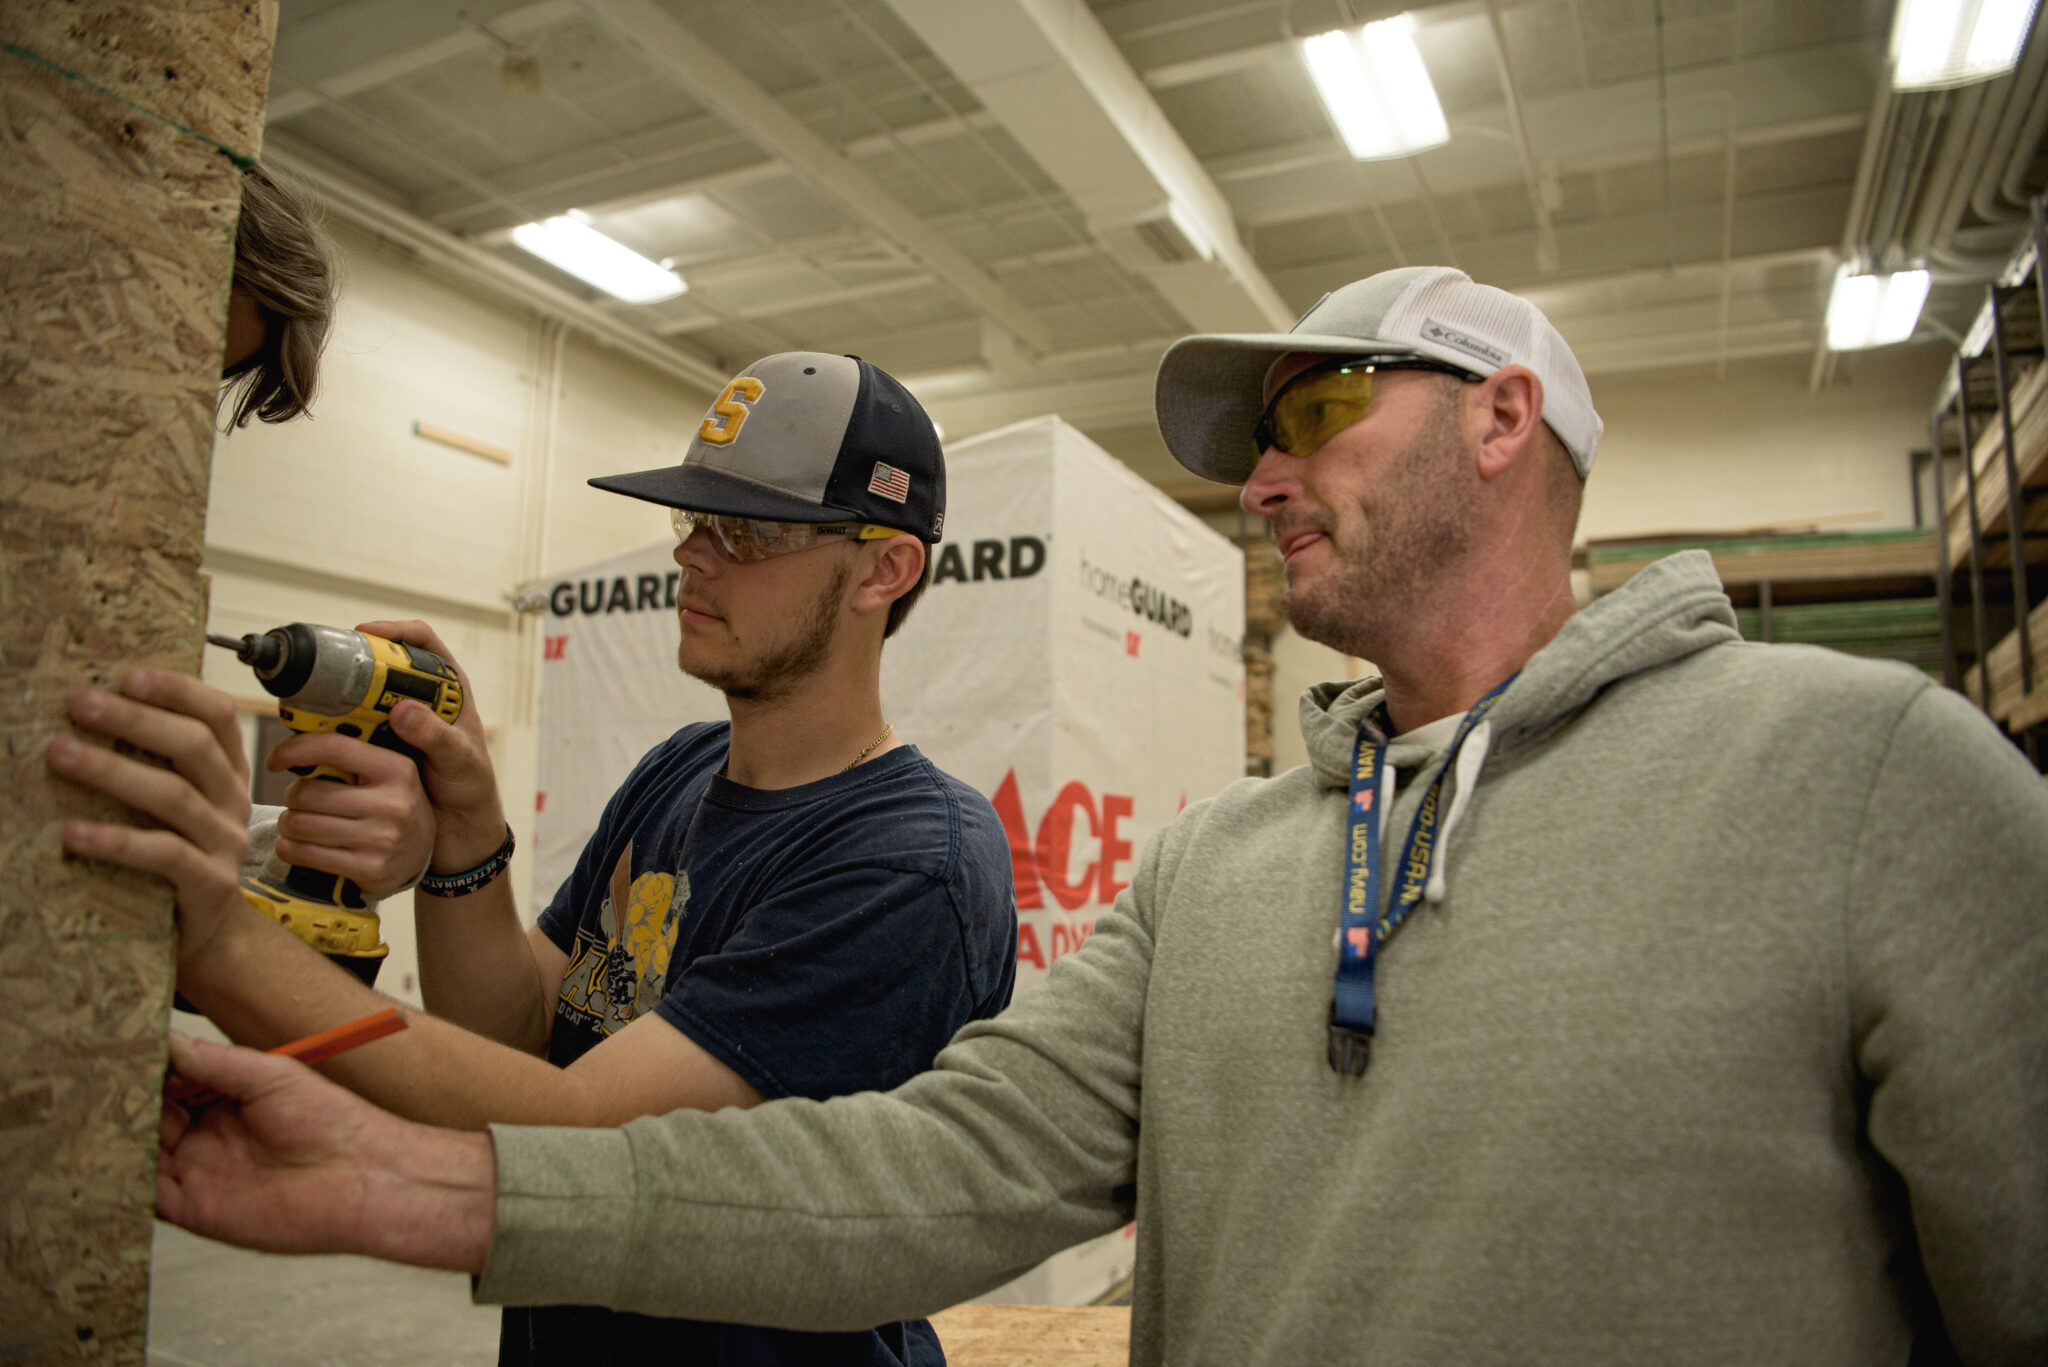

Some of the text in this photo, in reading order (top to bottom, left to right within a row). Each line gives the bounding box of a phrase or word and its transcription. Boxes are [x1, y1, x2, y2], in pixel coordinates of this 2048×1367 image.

[1444, 331, 1503, 362] Columbia
[699, 376, 766, 449] S
[1355, 740, 1377, 780] NAVY
[992, 765, 1135, 912] ACE
[1348, 823, 1370, 915] navy.com
